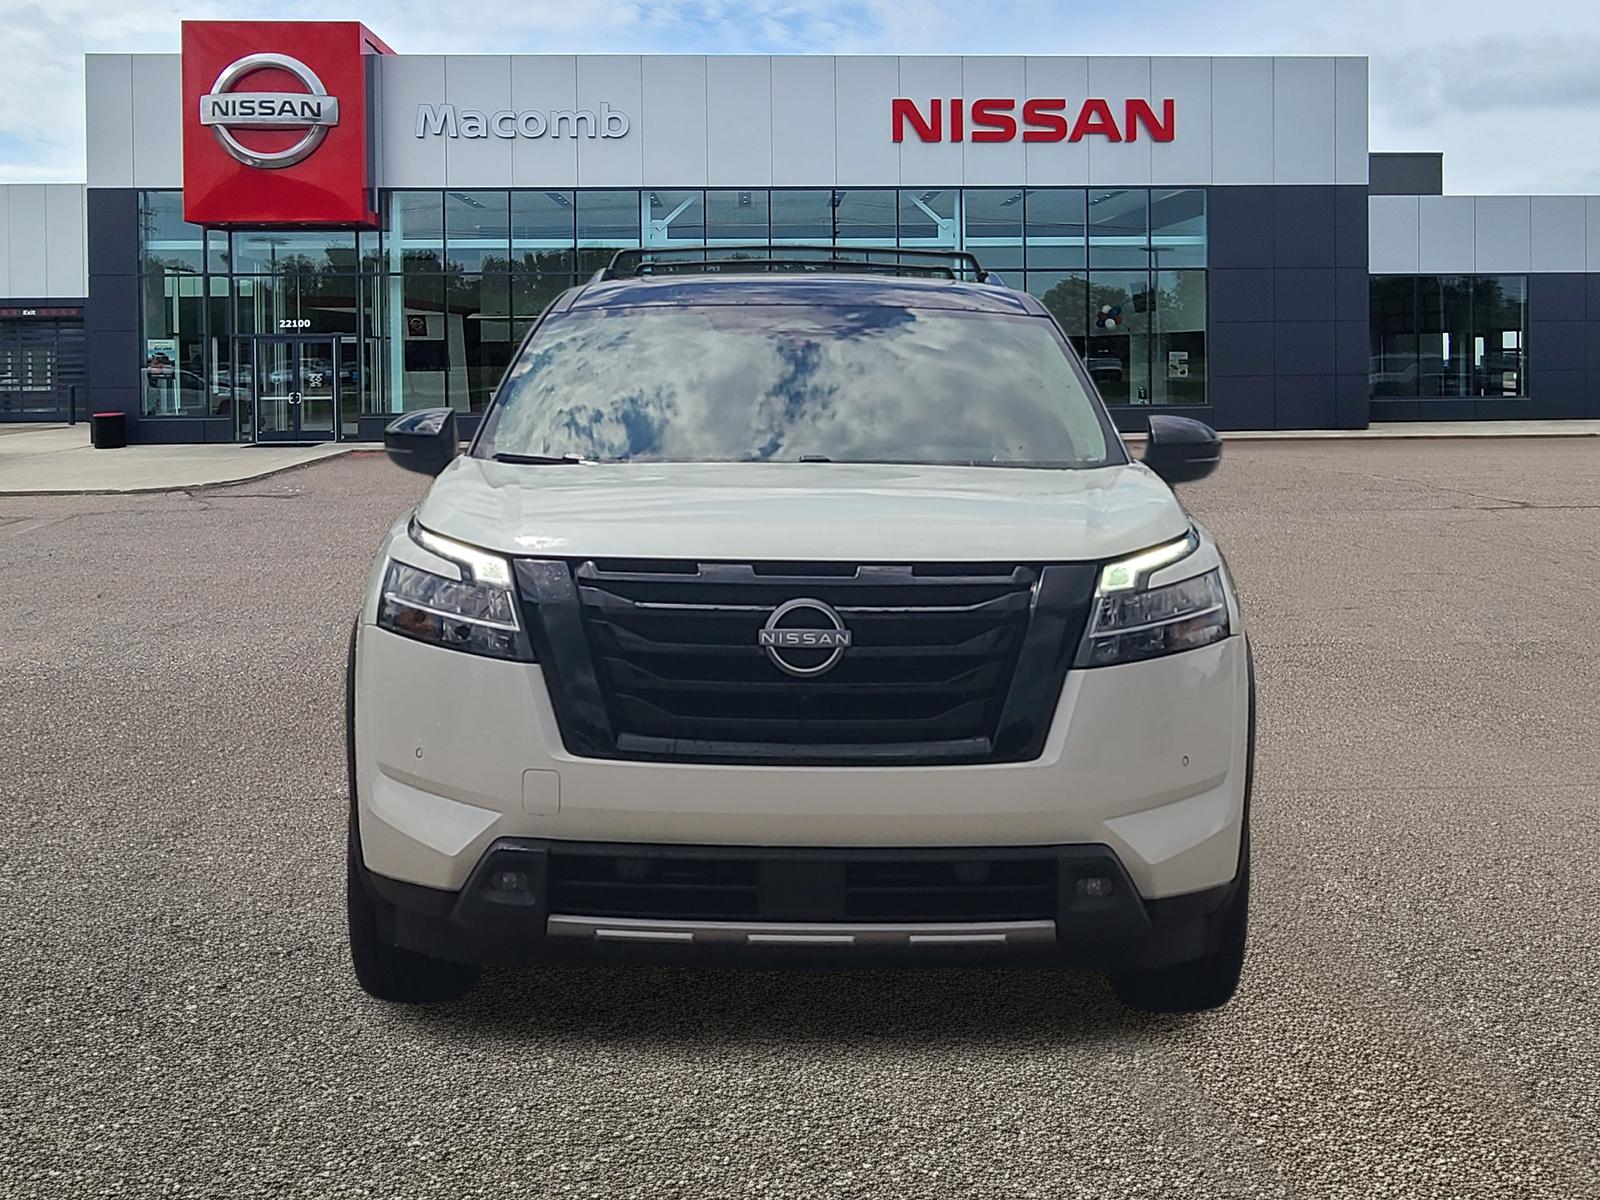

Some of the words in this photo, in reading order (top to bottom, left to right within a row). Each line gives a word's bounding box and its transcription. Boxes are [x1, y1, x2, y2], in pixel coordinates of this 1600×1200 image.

[212, 100, 322, 118] NISSAN
[415, 102, 630, 138] Macomb
[892, 98, 1175, 142] NISSAN
[279, 319, 311, 328] 22100
[761, 632, 849, 645] NISSAN
